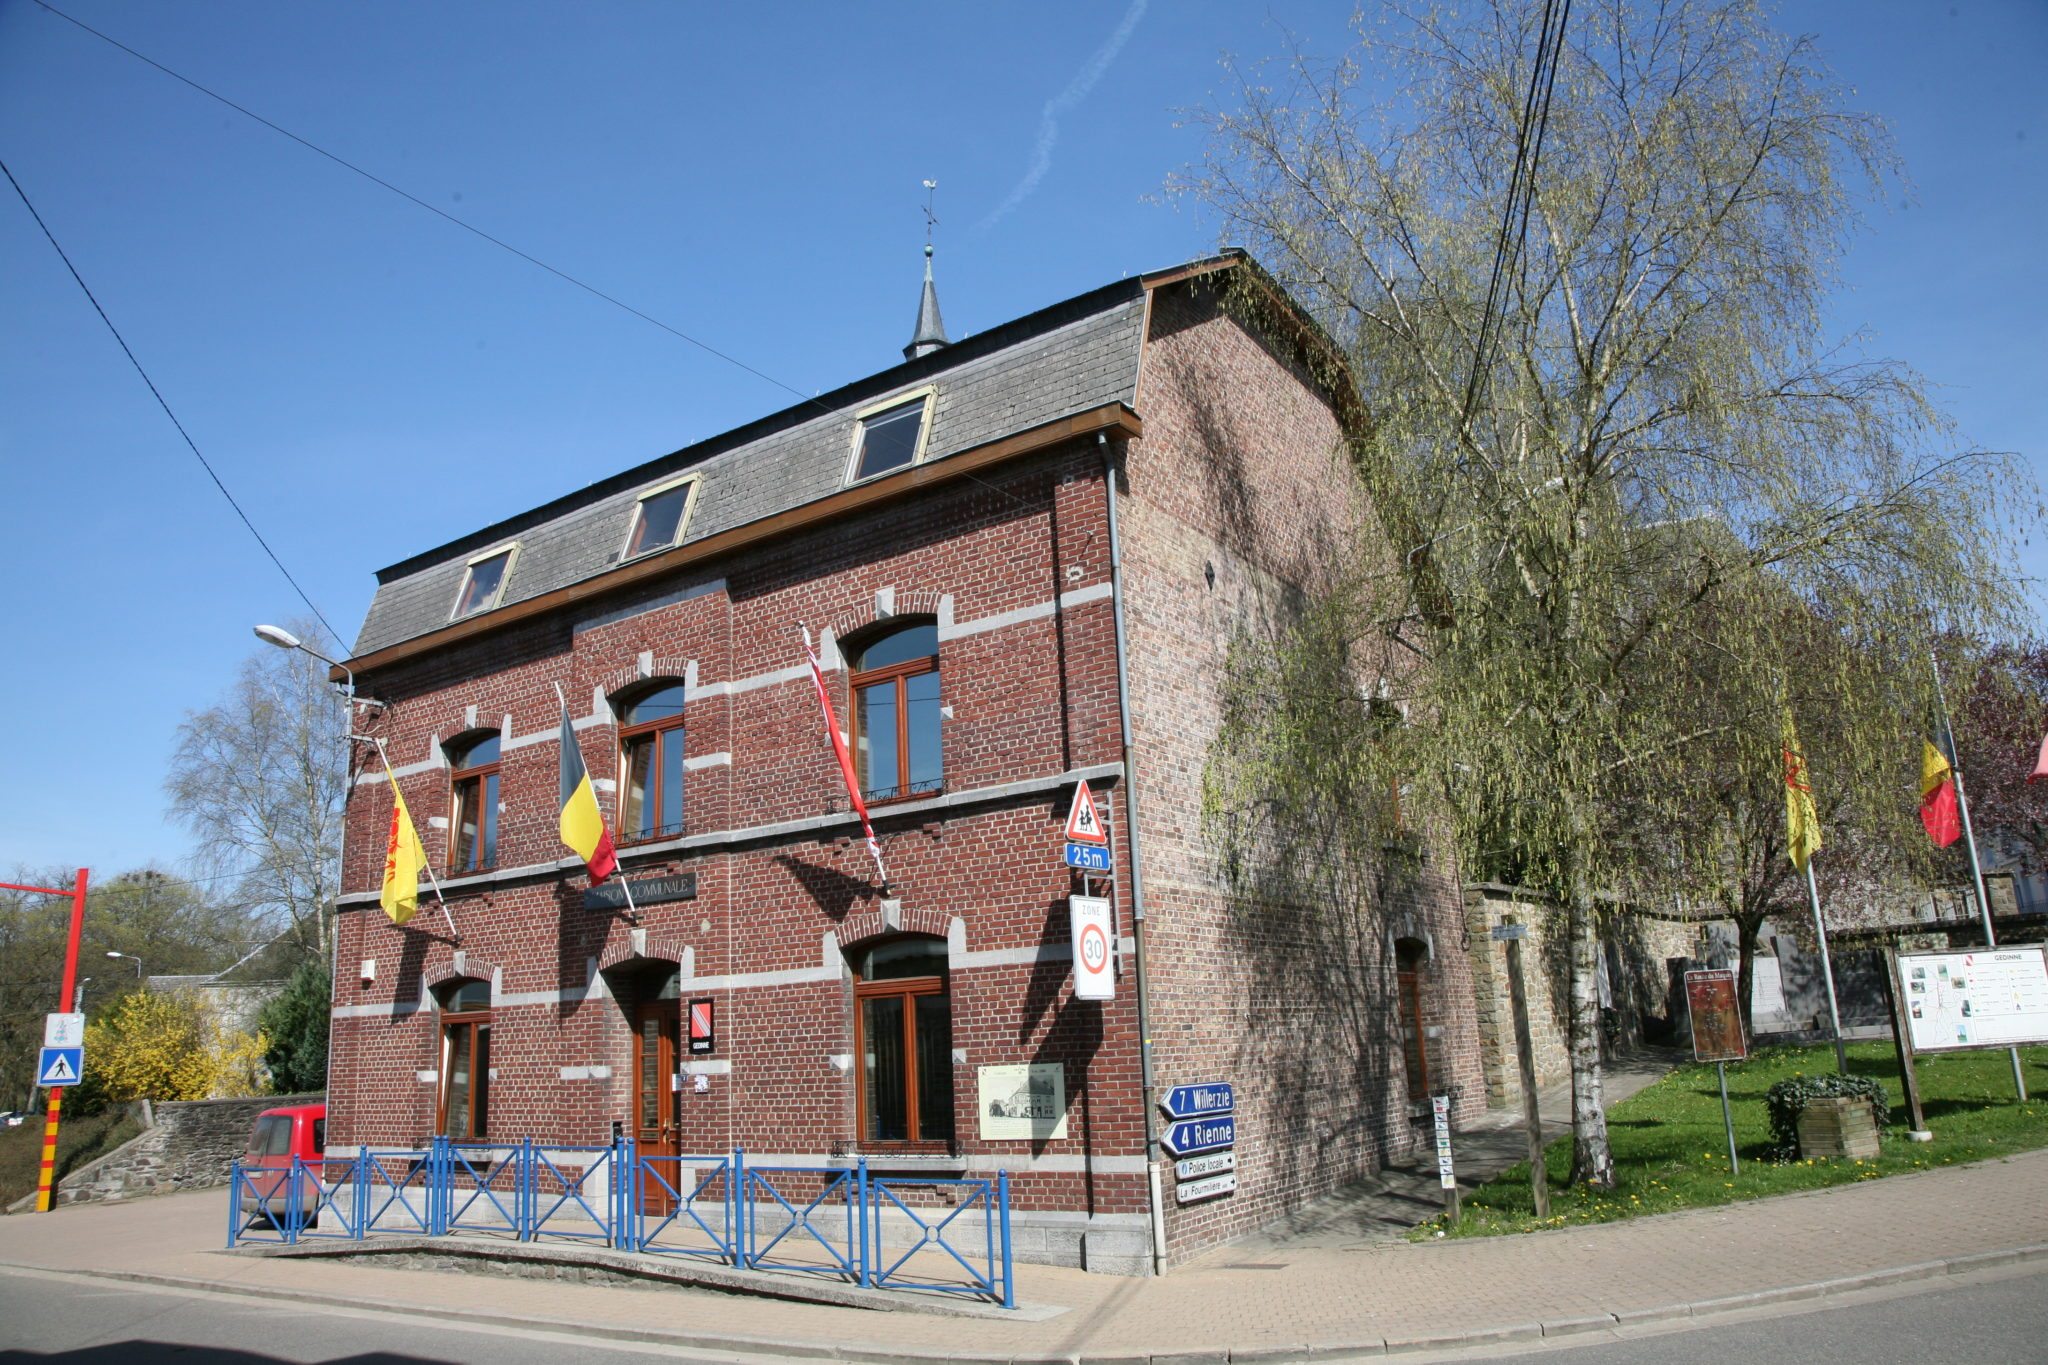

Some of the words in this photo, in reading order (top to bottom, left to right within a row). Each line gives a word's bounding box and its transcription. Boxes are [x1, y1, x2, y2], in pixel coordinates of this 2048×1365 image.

[1073, 847, 1103, 867] 25m
[596, 889, 625, 901] AISON
[629, 878, 688, 898] COMMUNALE
[1081, 904, 1101, 916] ZONE
[1086, 938, 1102, 960] 30
[1994, 953, 2022, 961] GEDINNE
[1180, 1091, 1186, 1111] 7
[1192, 1088, 1229, 1110] Willerzie
[1182, 1127, 1189, 1147] 4
[1195, 1124, 1232, 1146] Rienne
[1189, 1161, 1206, 1174] Police
[1208, 1157, 1224, 1172] locale
[1180, 1189, 1188, 1198] La
